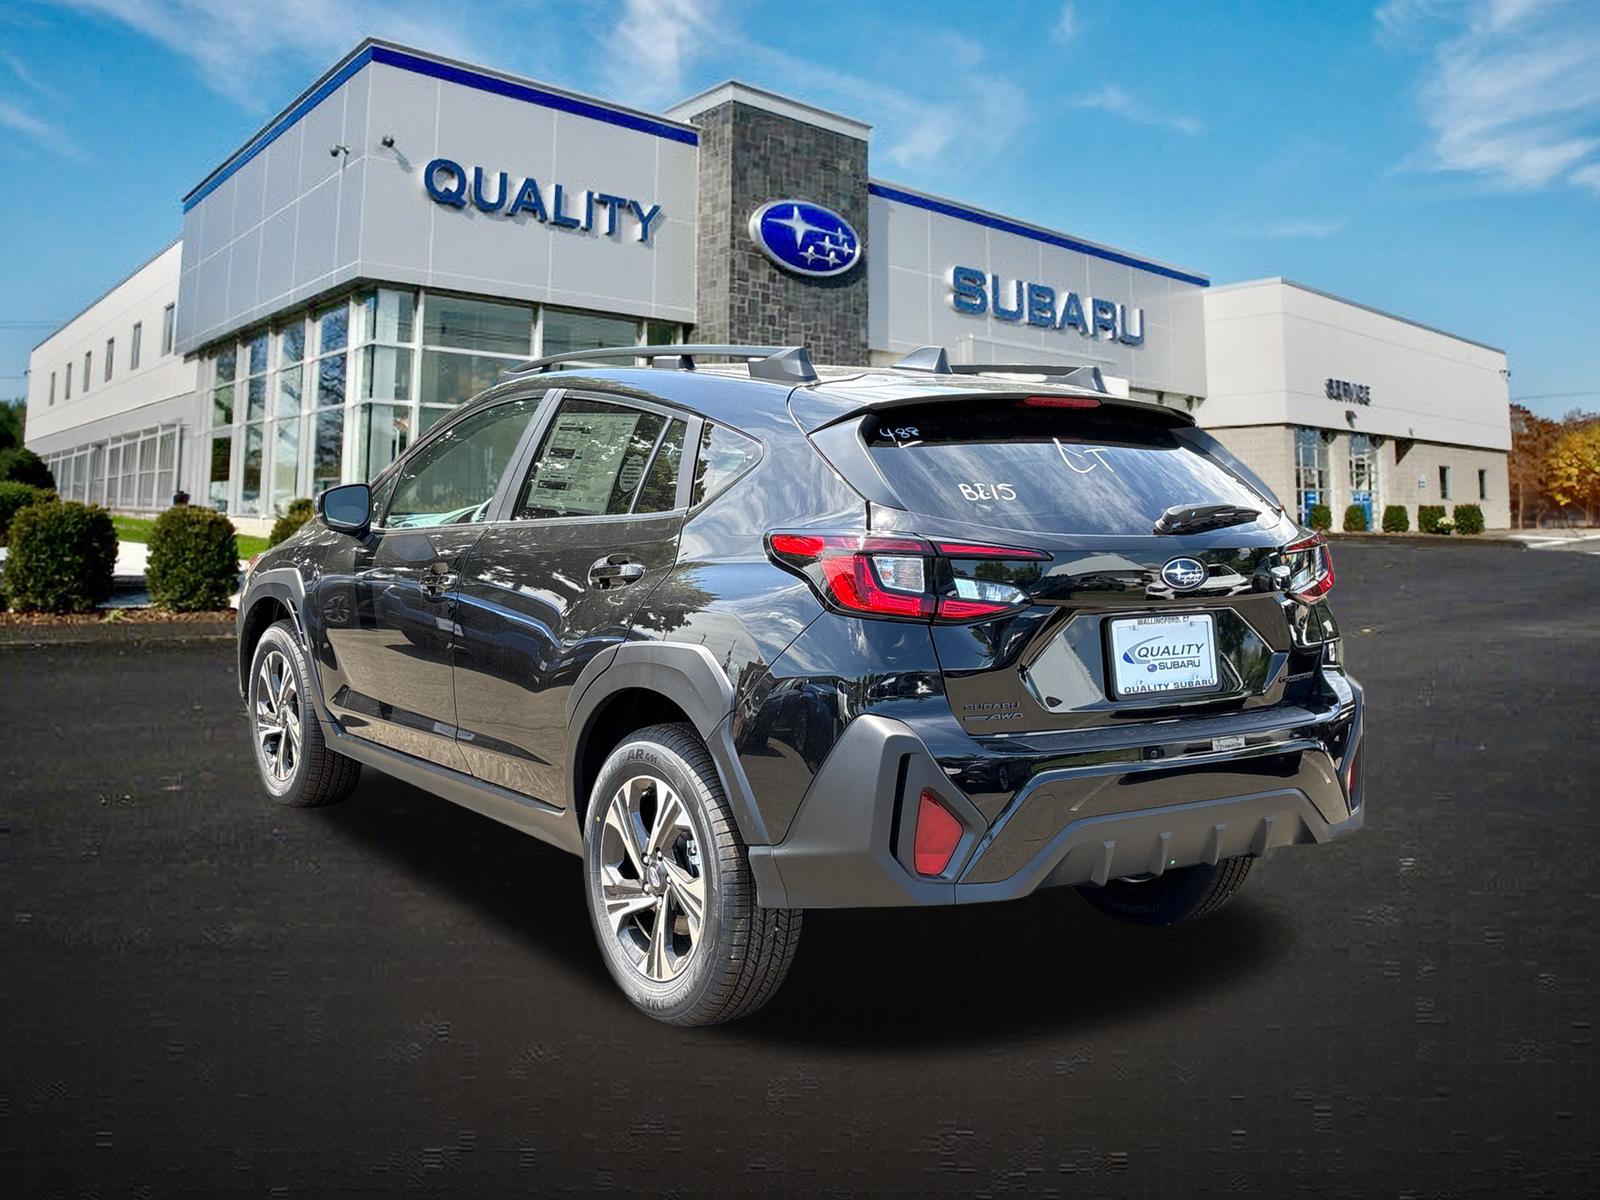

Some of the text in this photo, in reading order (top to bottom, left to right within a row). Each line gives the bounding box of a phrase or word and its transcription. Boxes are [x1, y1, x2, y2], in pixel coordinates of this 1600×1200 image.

[423, 157, 662, 244] QUALITY
[951, 265, 1146, 347] SUBARU
[1325, 378, 1371, 407] SERVICE
[1137, 643, 1205, 658] QUALITY
[1158, 659, 1201, 671] SUBARU
[1123, 678, 1215, 694] QUALITY SUBARU
[962, 702, 1020, 711] SUBARU
[987, 712, 1025, 721] AWD
